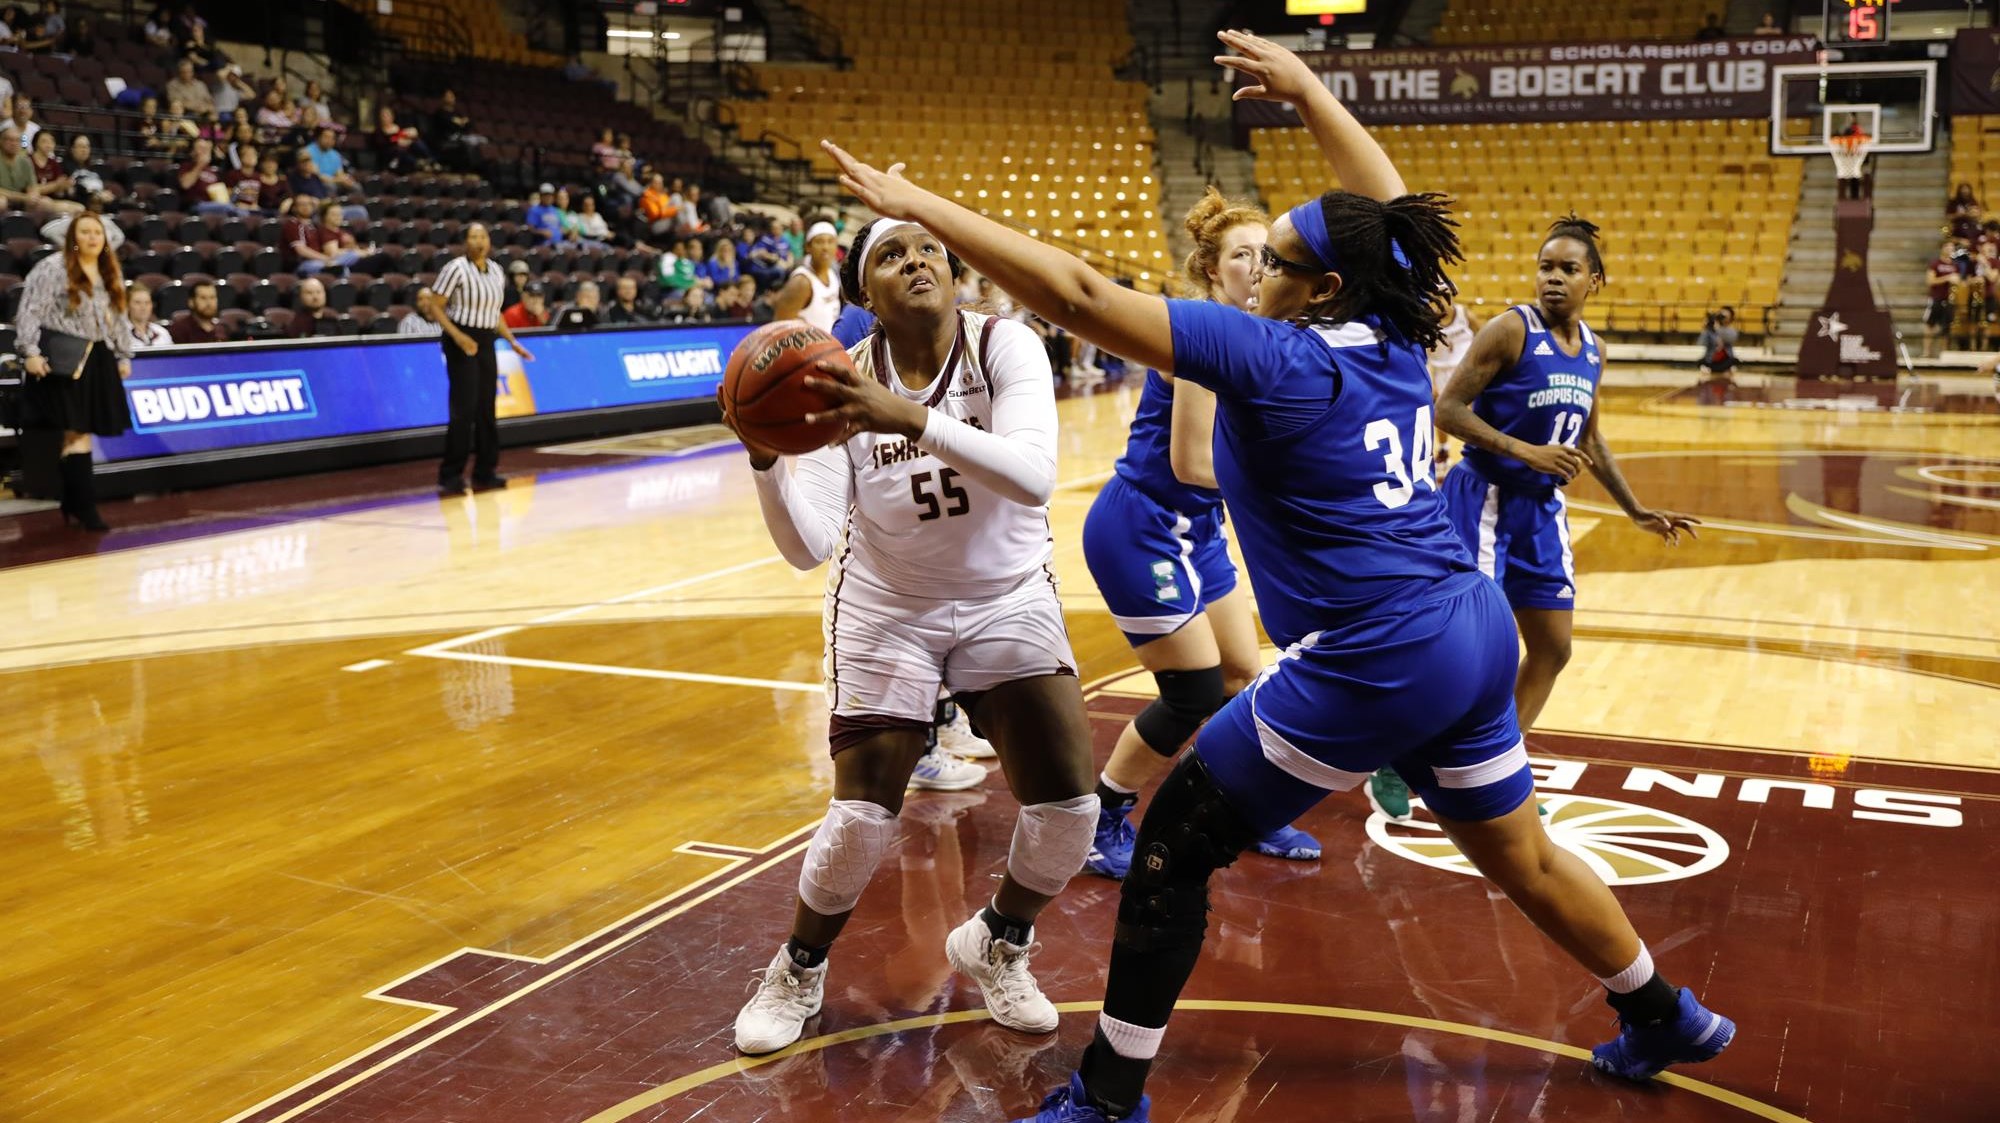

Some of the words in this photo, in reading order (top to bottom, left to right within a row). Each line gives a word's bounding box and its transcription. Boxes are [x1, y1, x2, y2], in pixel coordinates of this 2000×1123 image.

[1848, 7, 1877, 39] 15
[1340, 50, 1544, 67] STUDENT-ATHLETE
[1551, 43, 1730, 61] SCHOLARSHIPS
[1737, 38, 1817, 55] TODAY
[1370, 69, 1441, 101] THE
[1489, 64, 1646, 99] BOBCAT
[1660, 60, 1767, 95] CLUB
[623, 352, 670, 382] BUD
[667, 348, 723, 377] LIGHT
[1547, 373, 1577, 387] TEXAS
[131, 385, 211, 424] BUD
[208, 378, 306, 417] LIGHT
[1528, 388, 1573, 409] CORPUS
[1547, 411, 1583, 449] 12
[1363, 404, 1437, 509] 34
[911, 467, 970, 521] 55
